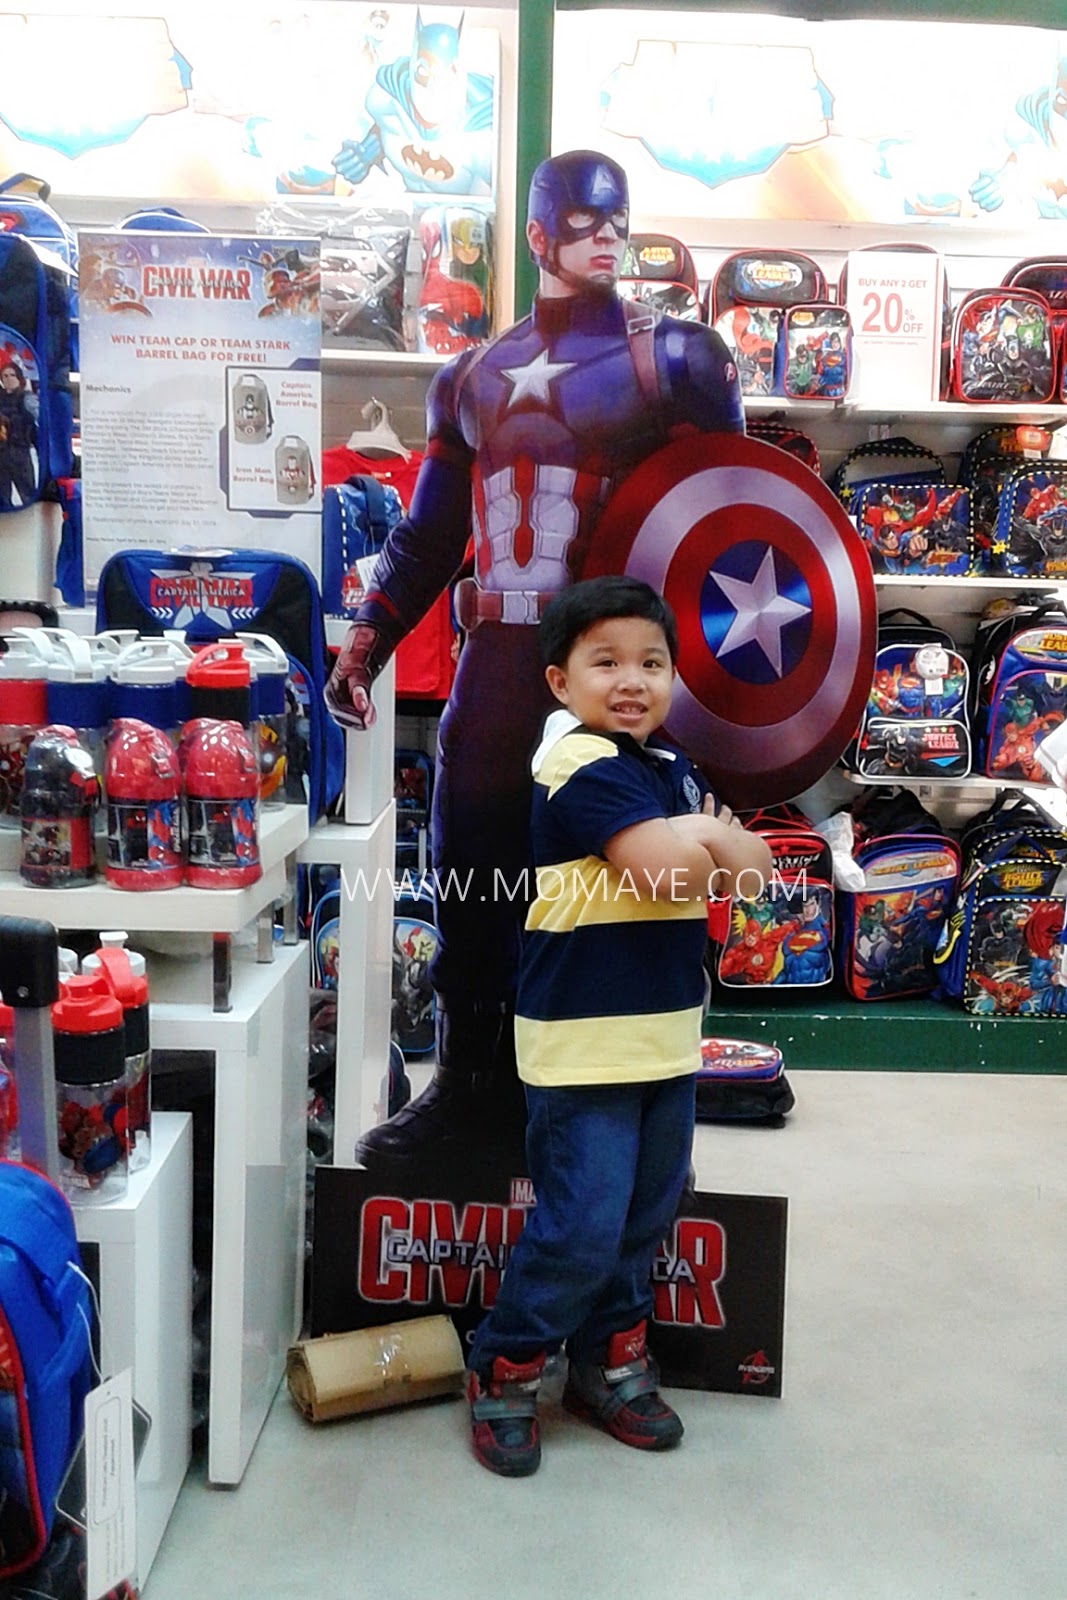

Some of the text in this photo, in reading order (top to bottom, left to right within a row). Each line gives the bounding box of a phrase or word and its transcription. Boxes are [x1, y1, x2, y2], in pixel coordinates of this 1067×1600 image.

[142, 265, 251, 300] CIVIL WAR
[858, 278, 928, 289] BUY ANY 2 GET
[862, 292, 903, 334] 20
[903, 323, 923, 333] OFF
[111, 334, 291, 350] WIN TEAM CAP OR TEAM STARK
[136, 349, 267, 363] BARREL BAG FOR FREE!
[85, 384, 132, 394] Mechanics
[281, 381, 312, 391] Captain
[281, 391, 313, 399] America
[276, 400, 318, 409] Barrel Bag
[235, 467, 271, 475] Iron Man
[233, 475, 257, 483] Barrel
[386, 1237, 508, 1269] CAPTAI
